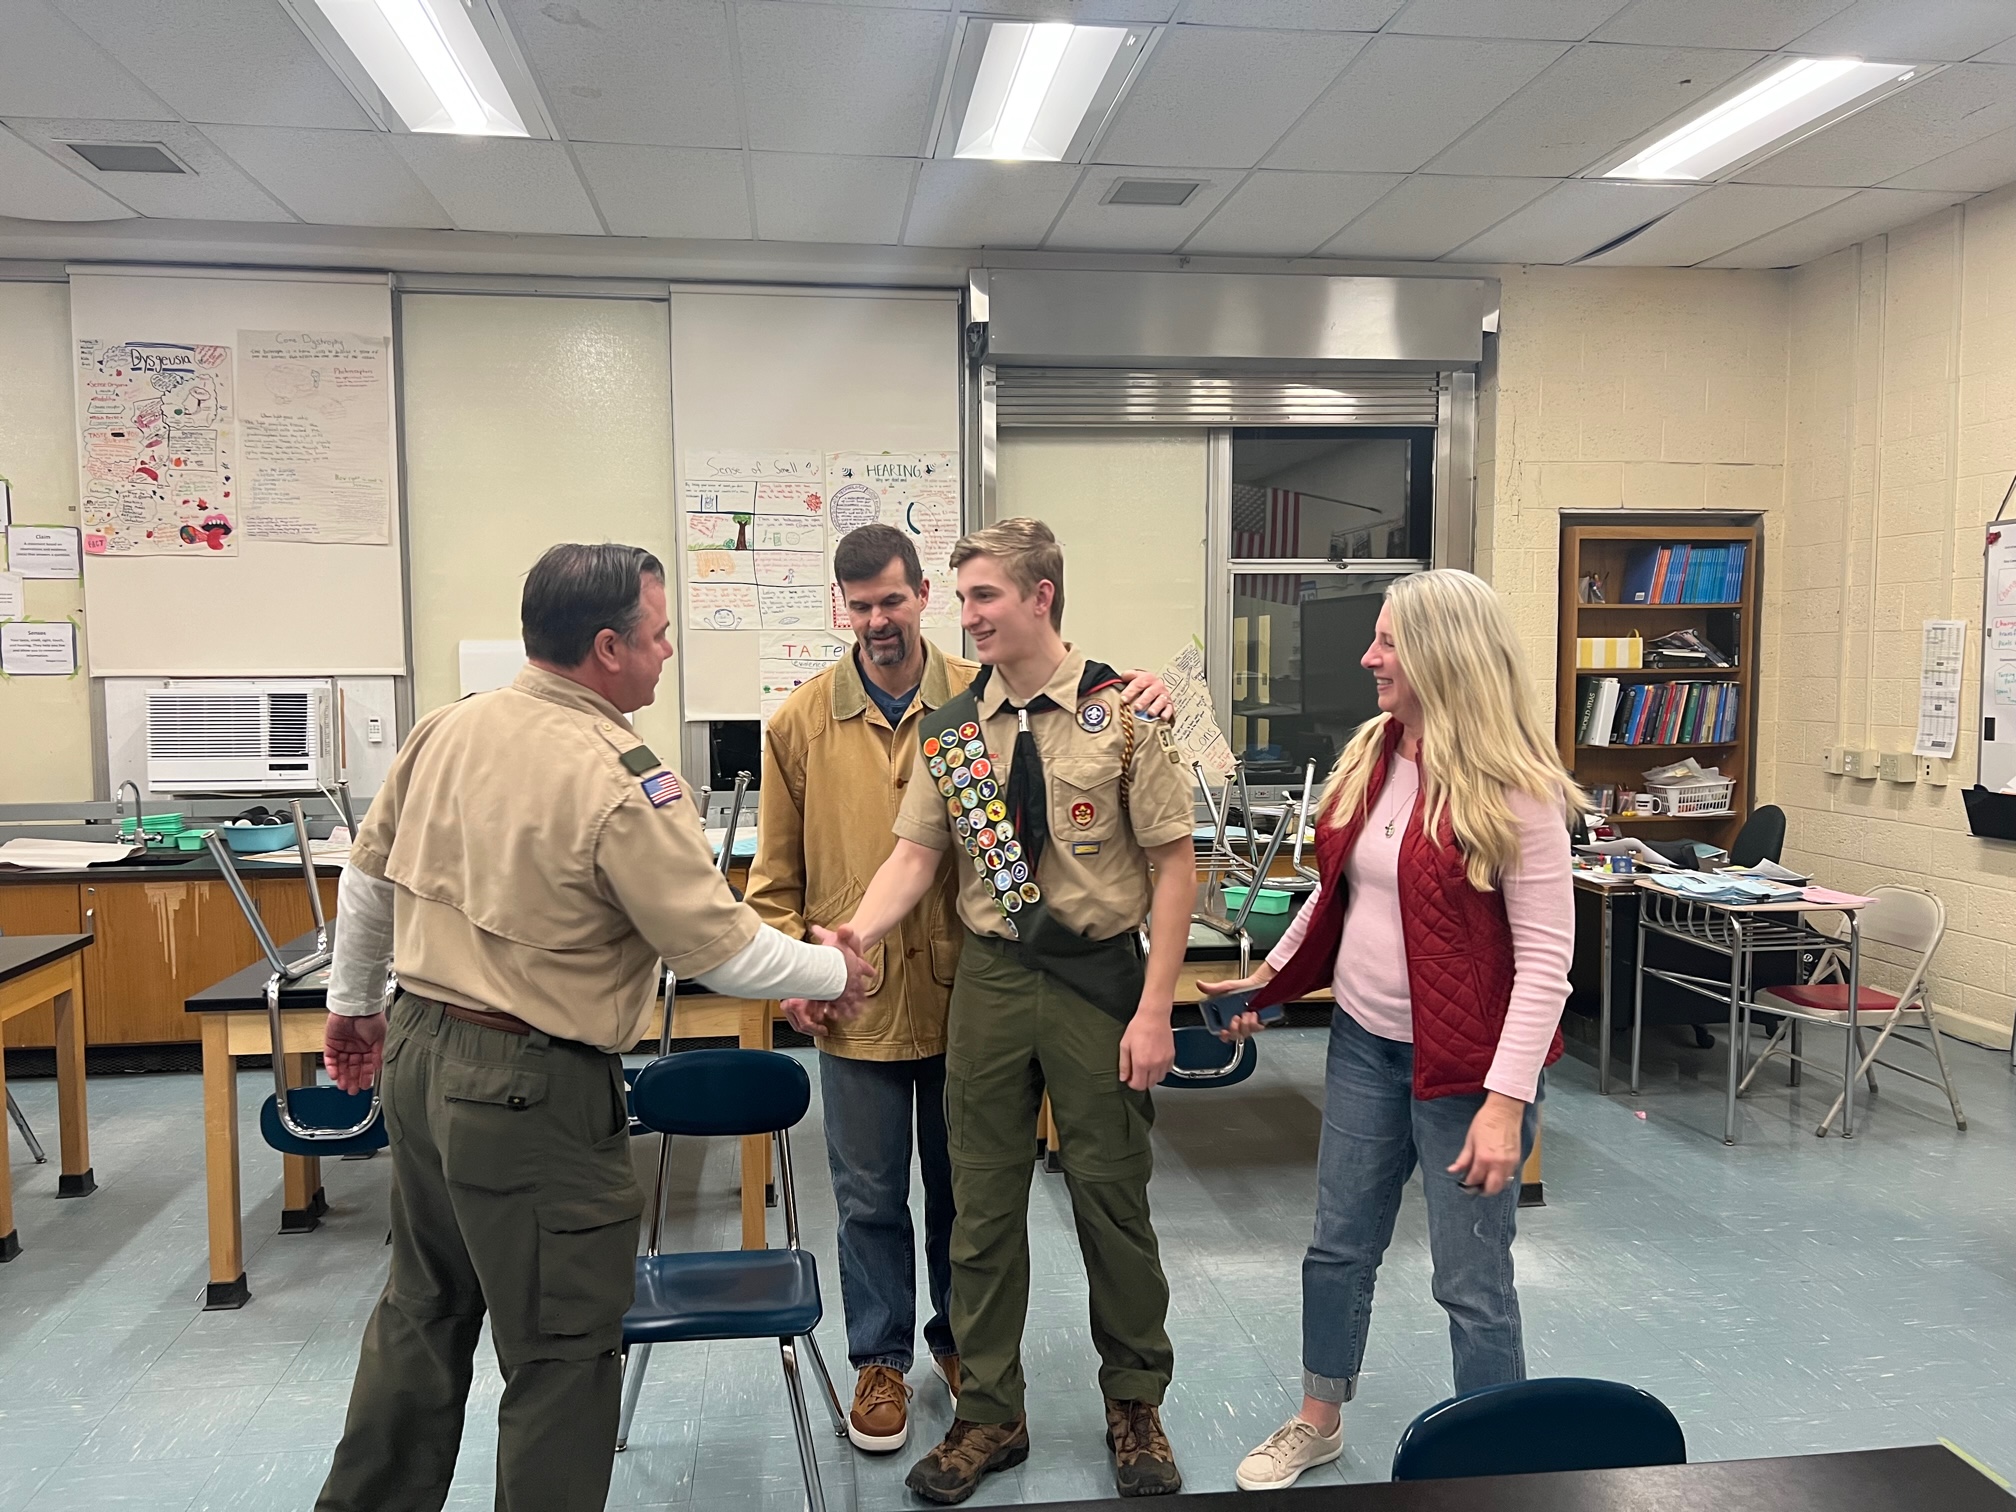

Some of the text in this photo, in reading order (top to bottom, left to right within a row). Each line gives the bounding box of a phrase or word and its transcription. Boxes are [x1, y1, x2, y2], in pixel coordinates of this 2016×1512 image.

[275, 333, 345, 350] Cone Dystrophy
[131, 348, 192, 373] Dysgeusia
[706, 457, 797, 478] Sense of Smell
[88, 540, 104, 548] FACT
[1188, 727, 1217, 752] Cons
